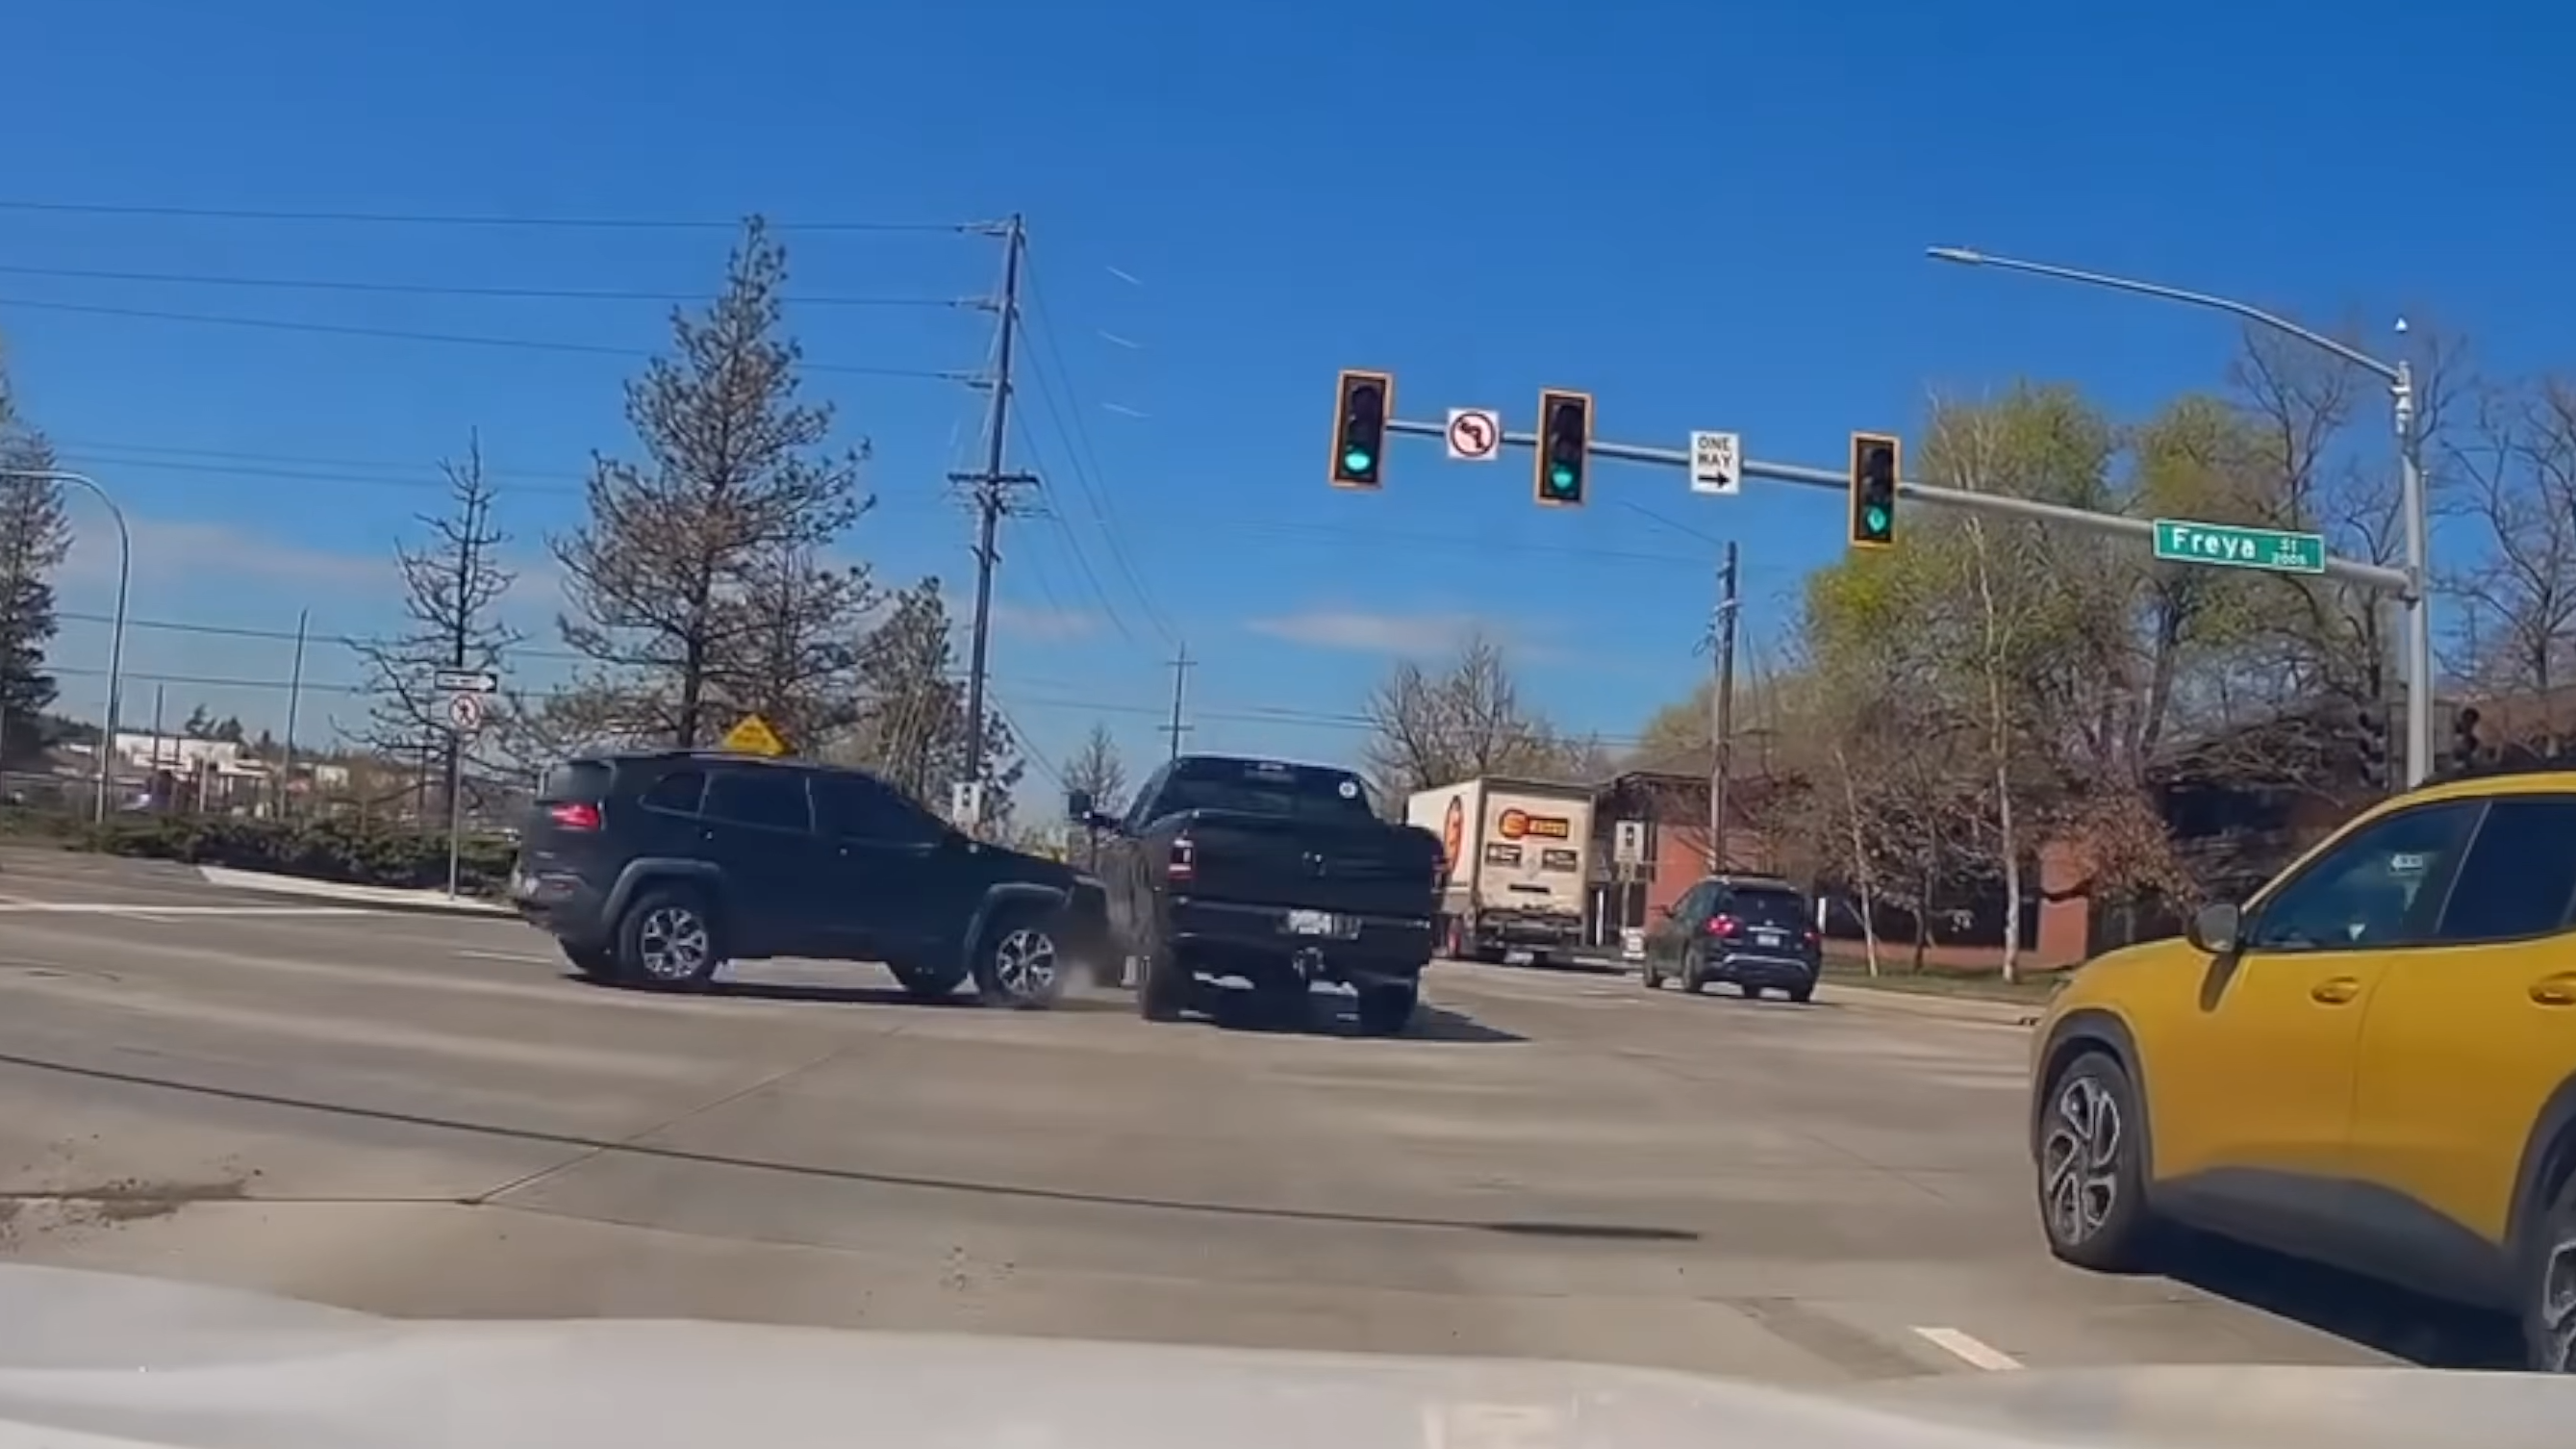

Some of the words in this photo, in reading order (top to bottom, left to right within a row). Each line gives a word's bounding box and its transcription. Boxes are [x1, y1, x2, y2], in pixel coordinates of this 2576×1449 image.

[1698, 436, 1731, 452] ONE
[1698, 452, 1732, 470] WAY
[2172, 528, 2256, 559] Freya
